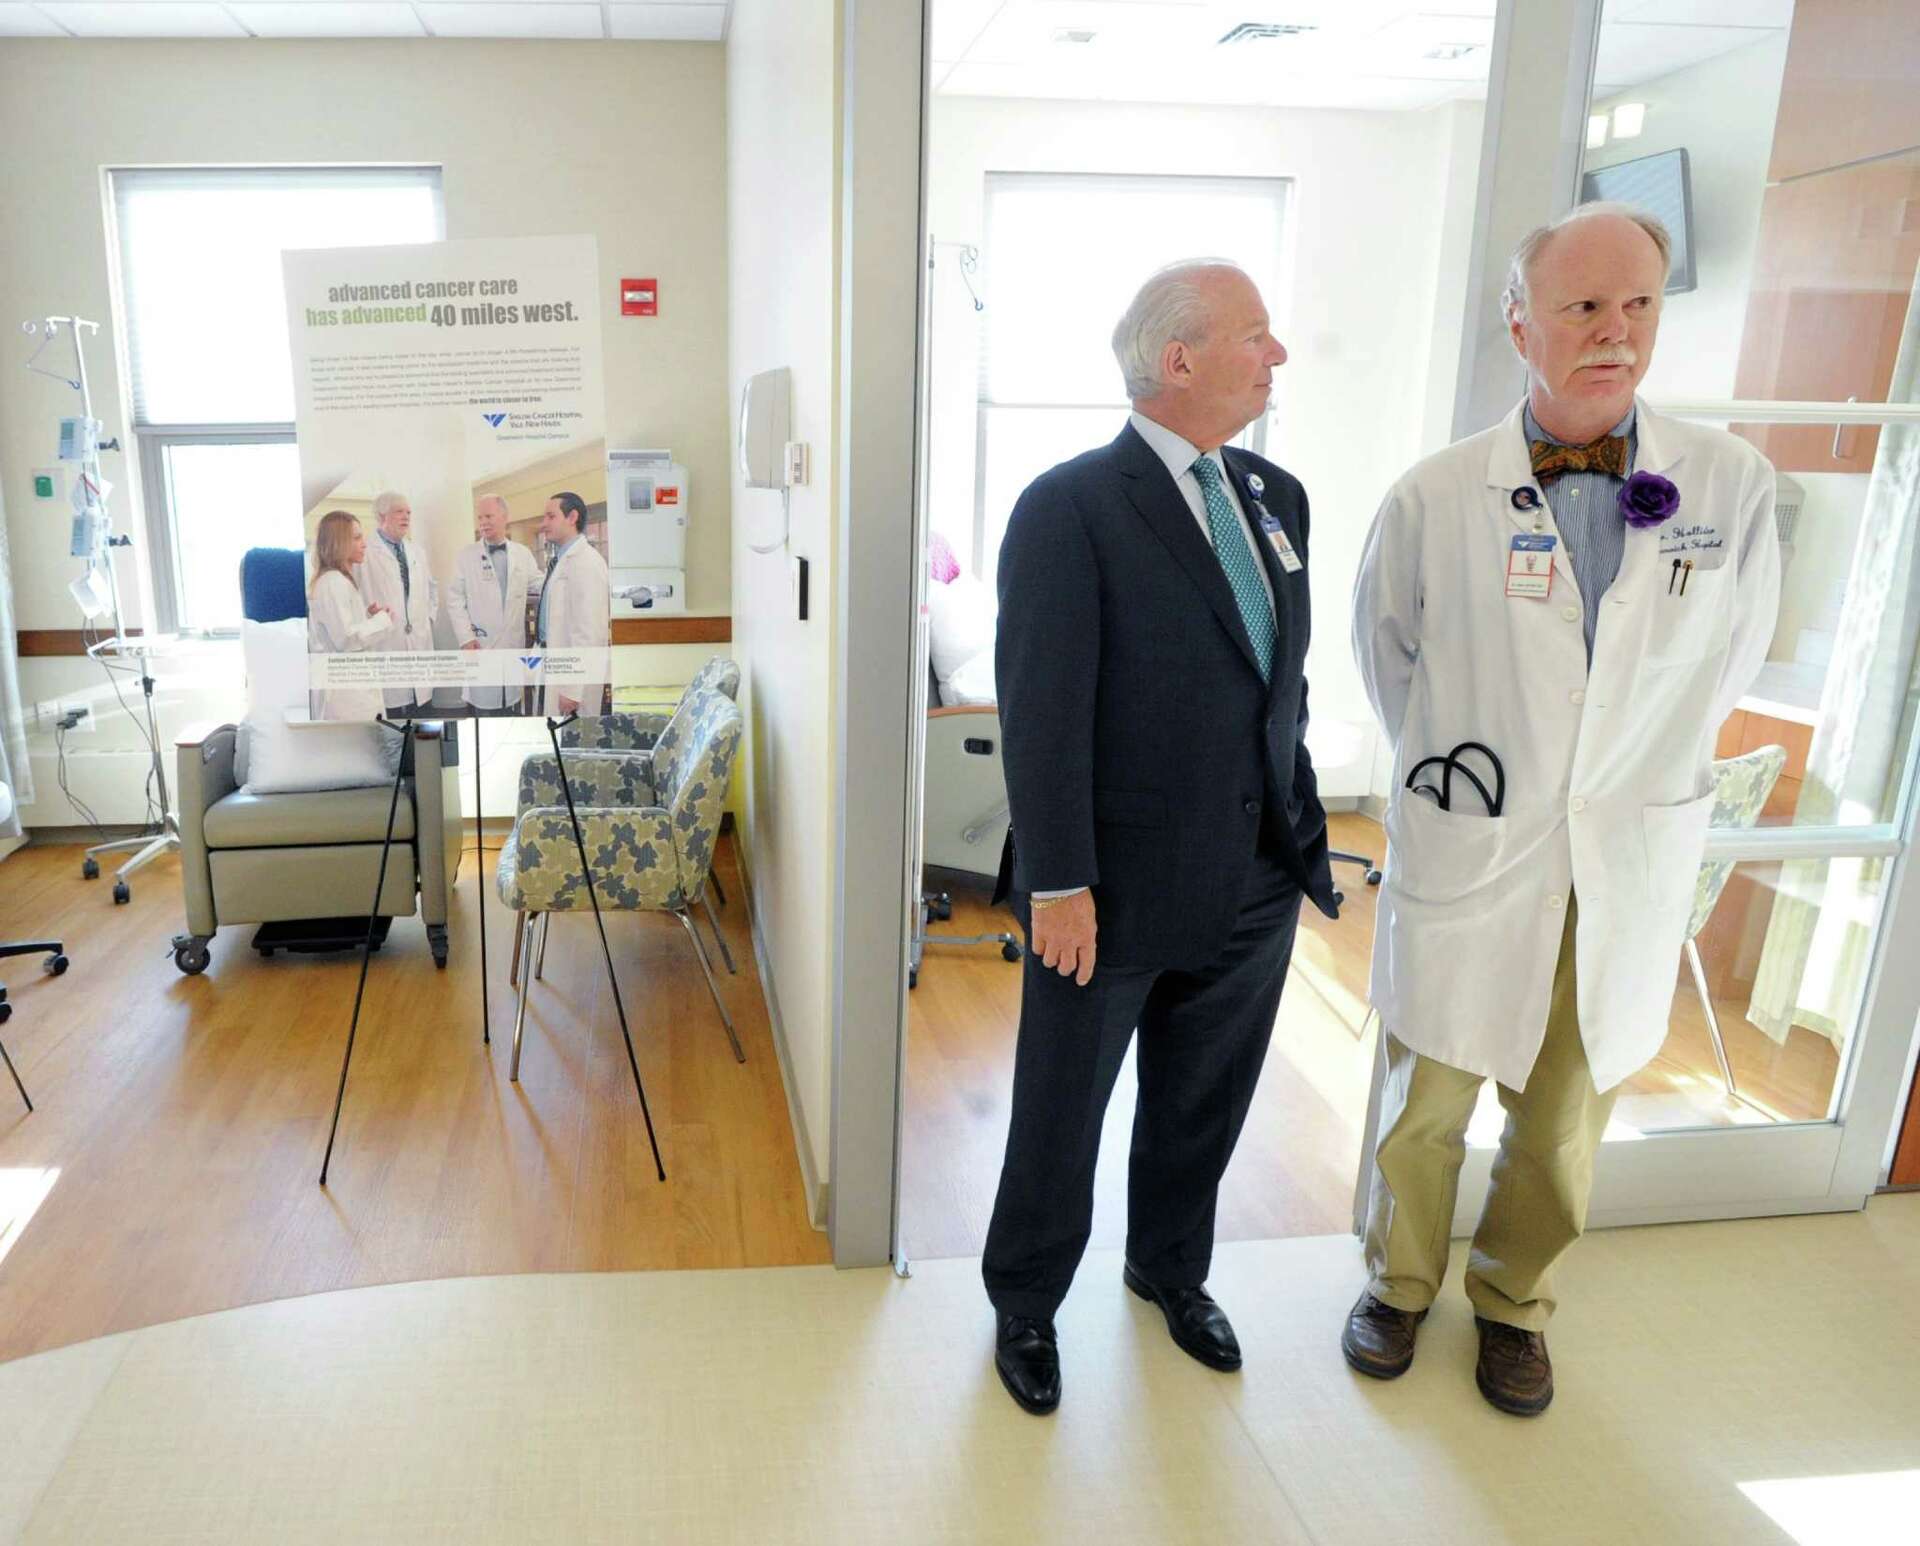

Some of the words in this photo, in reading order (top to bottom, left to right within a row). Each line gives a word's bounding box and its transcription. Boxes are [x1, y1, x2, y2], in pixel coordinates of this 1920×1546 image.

[328, 281, 411, 303] advanced
[415, 280, 475, 299] cancer
[479, 278, 518, 296] care
[306, 308, 337, 327] has
[341, 303, 426, 325] advanced
[430, 304, 456, 327] 40
[461, 302, 519, 325] miles
[523, 301, 579, 323] west.
